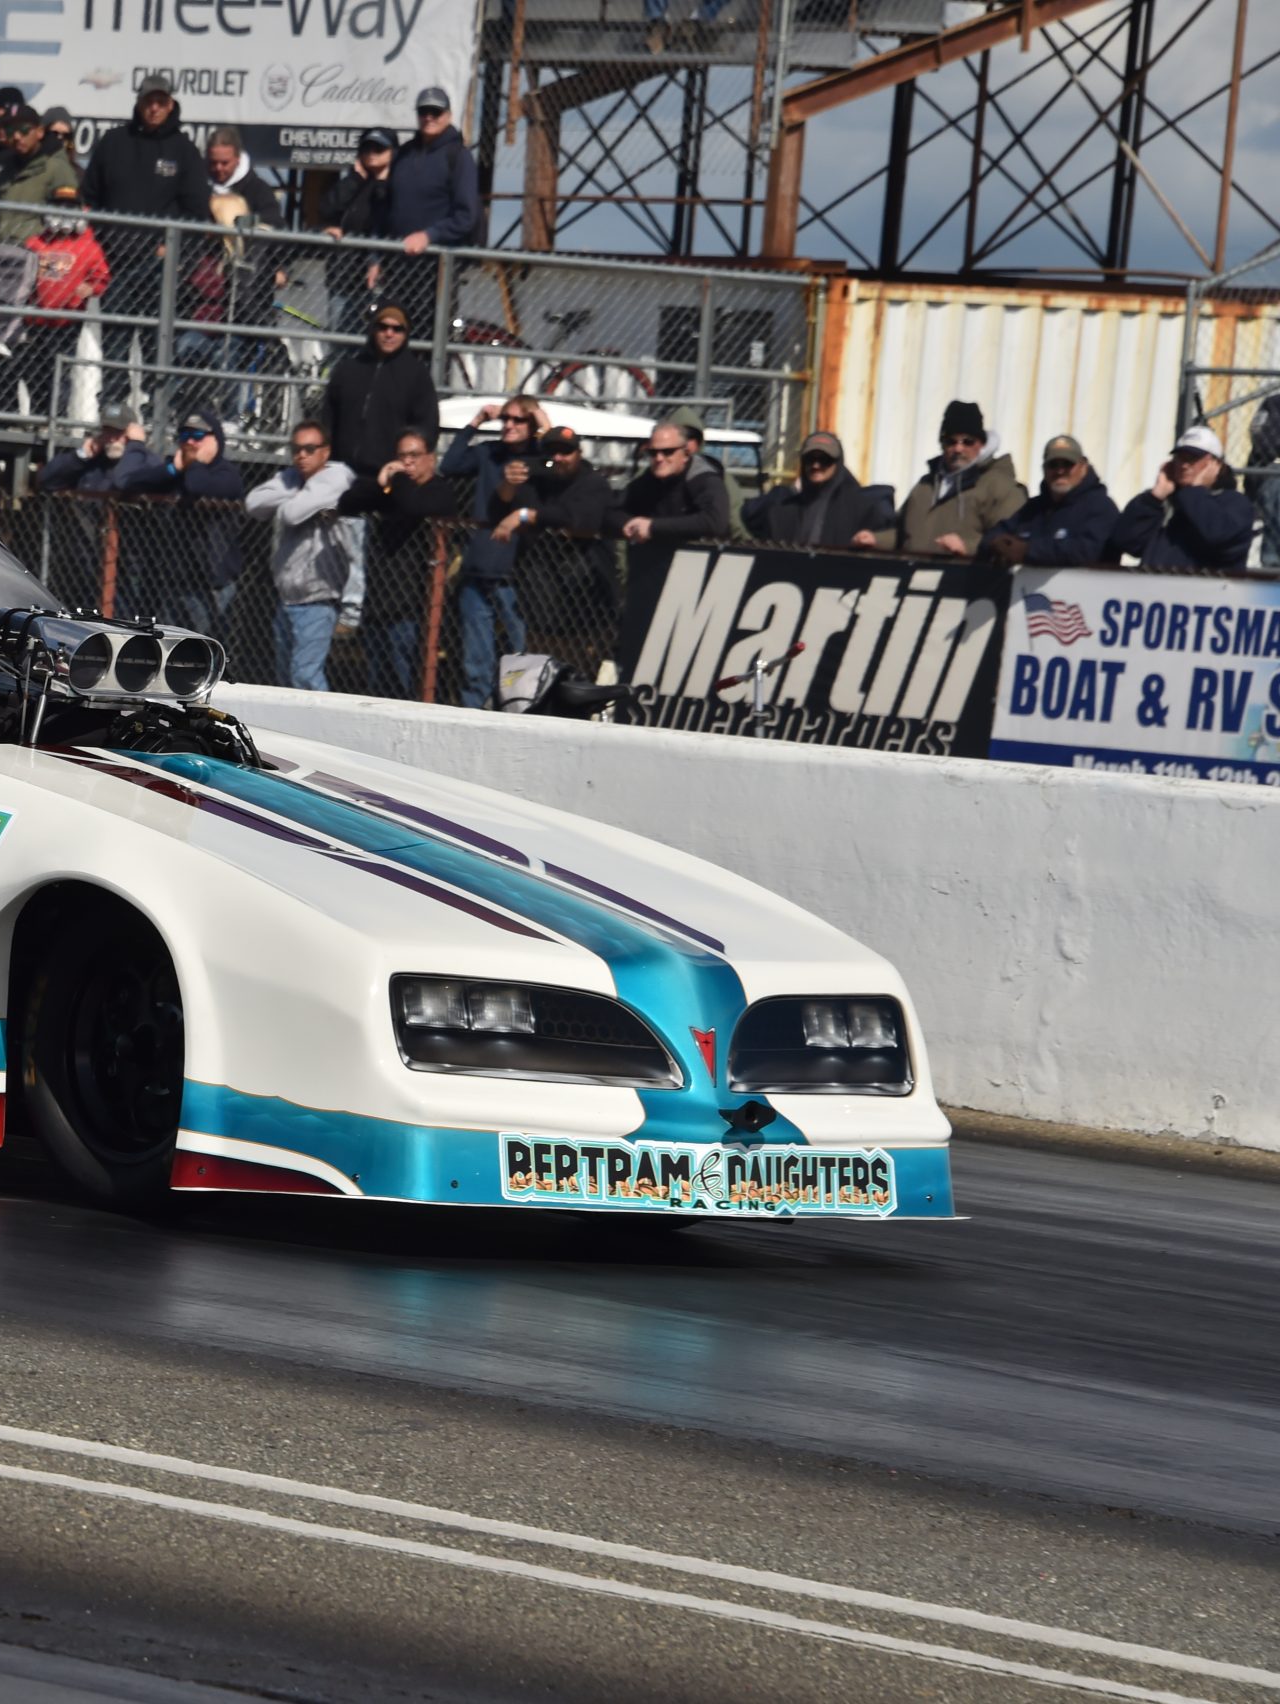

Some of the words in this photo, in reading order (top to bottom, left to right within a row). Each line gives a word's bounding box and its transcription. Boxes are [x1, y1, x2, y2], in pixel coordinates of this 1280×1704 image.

[299, 62, 409, 107] Cadillac
[279, 129, 361, 149] CHEVROLE
[631, 549, 999, 723] Martin
[1009, 654, 1127, 723] BOAT
[1136, 673, 1170, 728] &
[1185, 666, 1254, 734] RV
[507, 1140, 690, 1201] BERTRAM
[727, 1150, 889, 1207] DAUGHTERS
[669, 1196, 777, 1212] RACING
